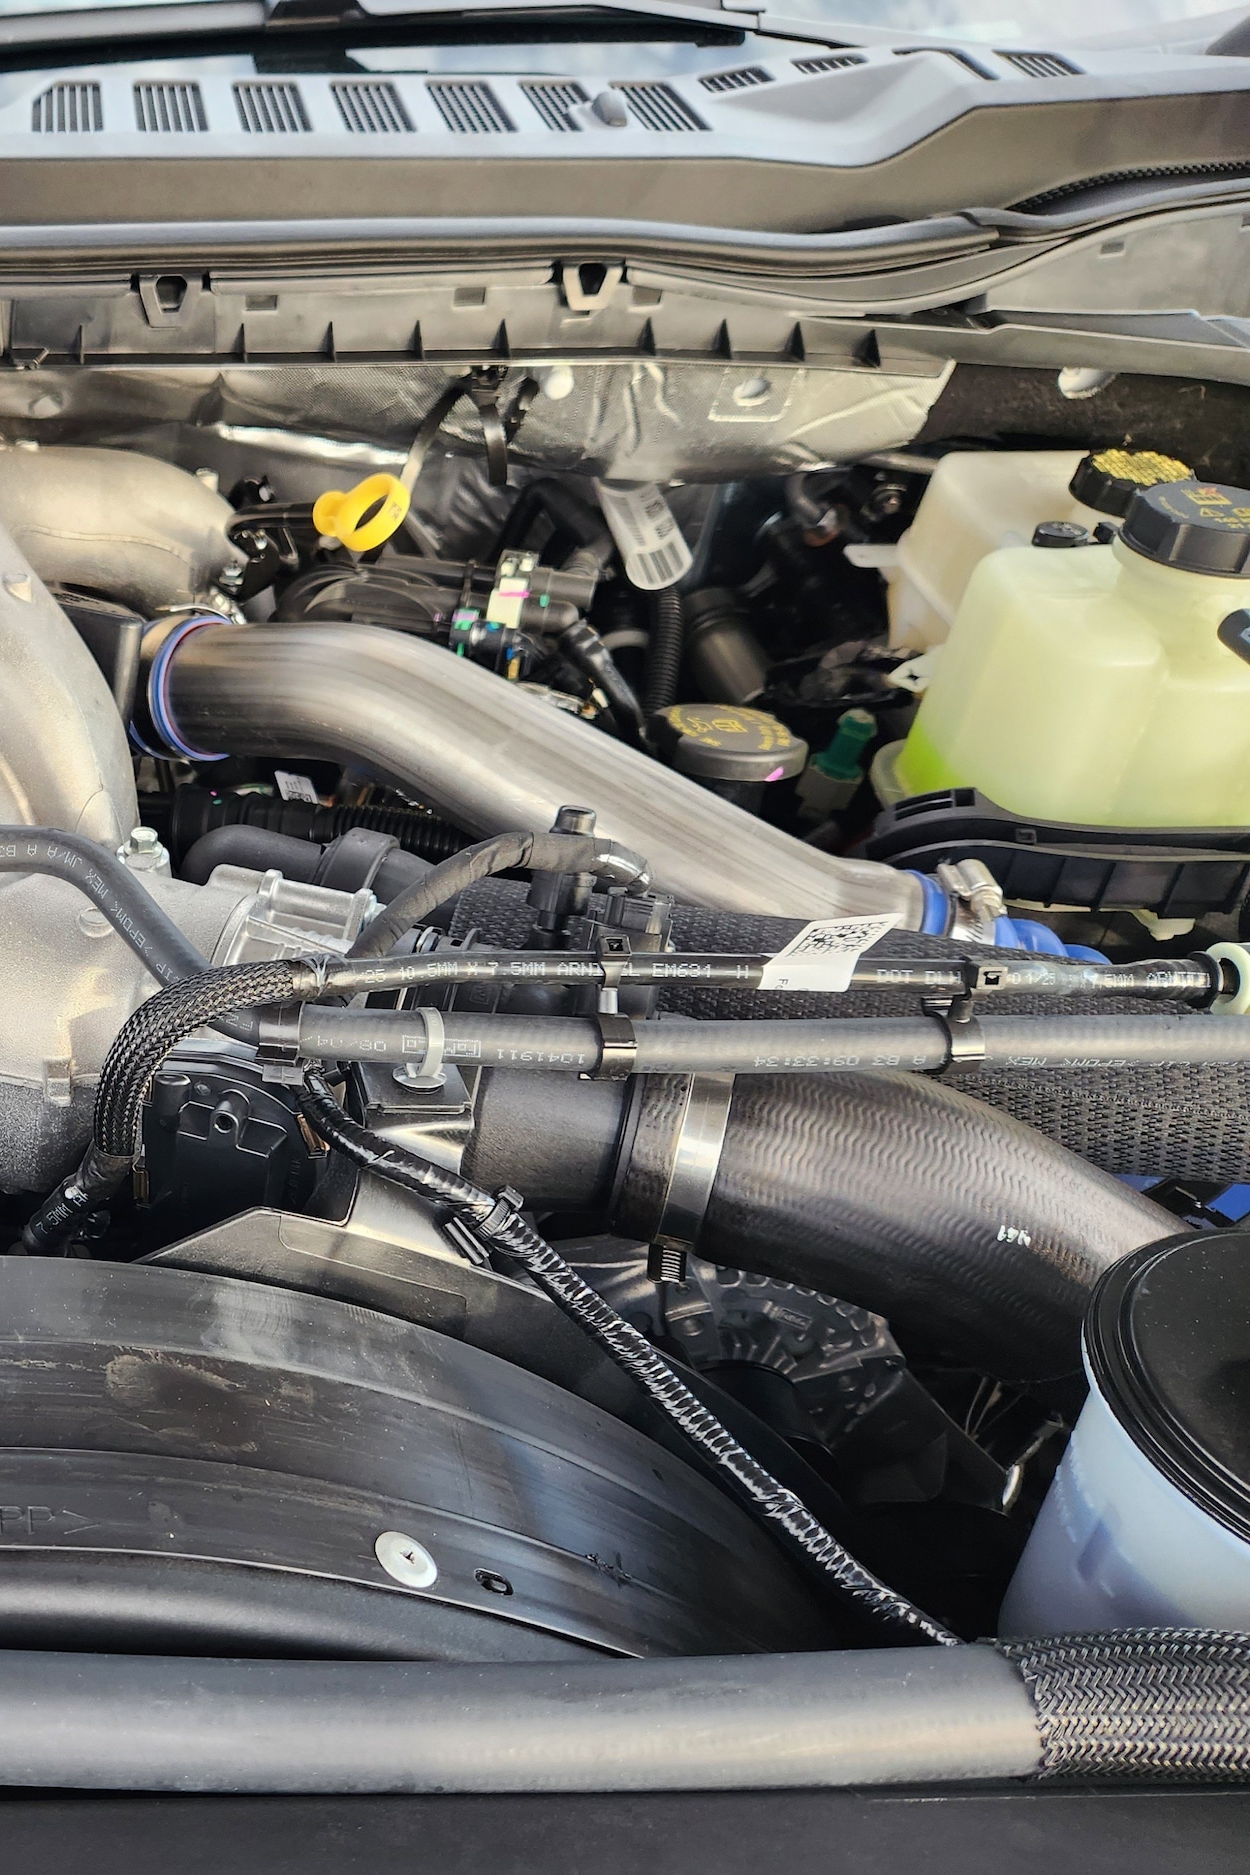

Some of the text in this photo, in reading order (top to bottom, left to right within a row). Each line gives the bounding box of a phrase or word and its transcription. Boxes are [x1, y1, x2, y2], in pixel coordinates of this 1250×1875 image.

[27, 844, 37, 857] A
[85, 868, 109, 899] MEX
[487, 961, 546, 977] 7.5MM
